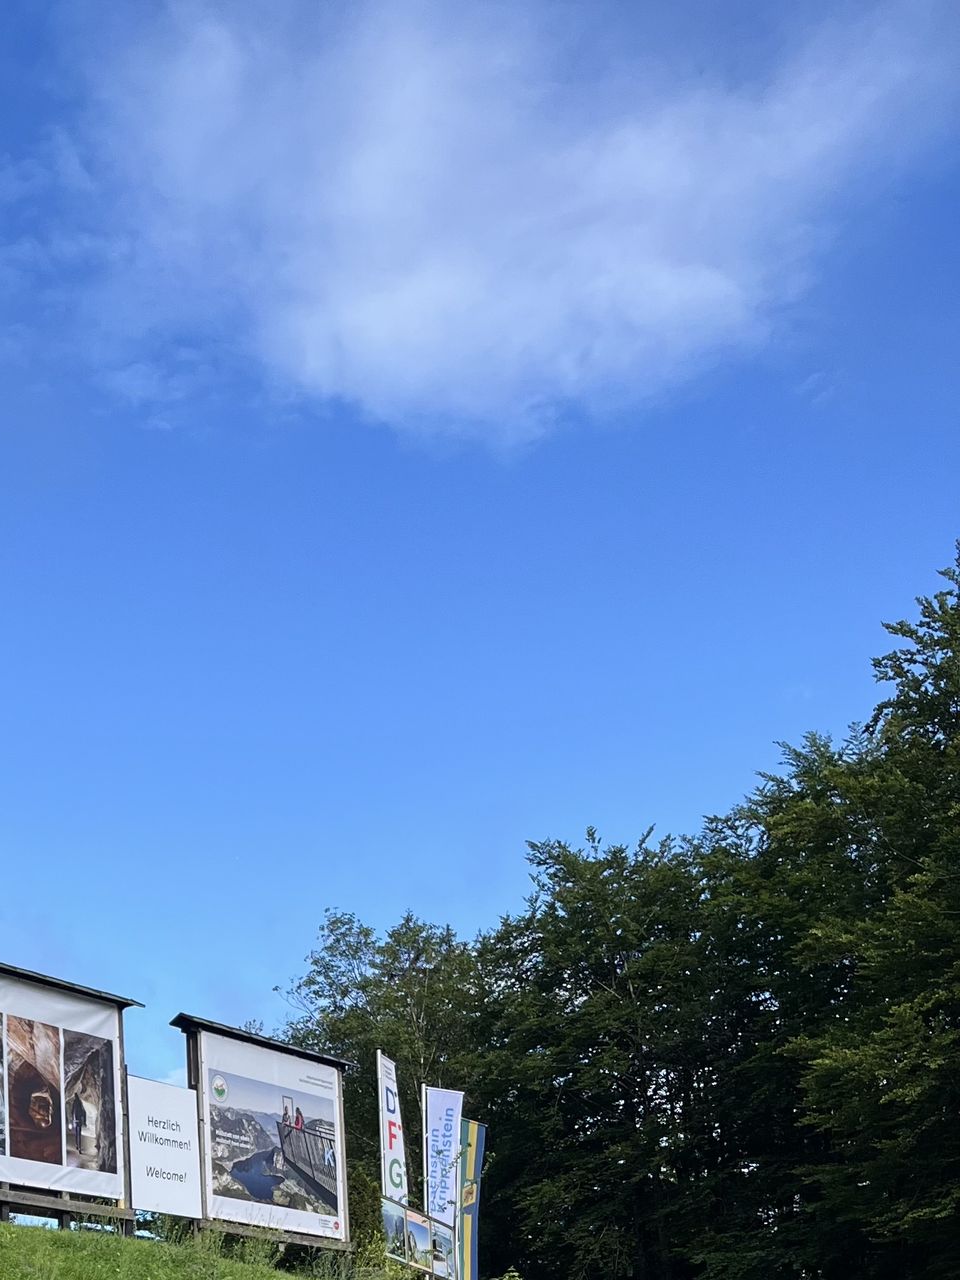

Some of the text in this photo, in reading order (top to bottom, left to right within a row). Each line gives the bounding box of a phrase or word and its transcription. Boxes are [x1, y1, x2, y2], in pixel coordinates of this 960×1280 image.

[147, 1115, 181, 1132] Herzlich
[137, 1130, 192, 1151] Willkommen!
[145, 1166, 187, 1183] Welcome!
